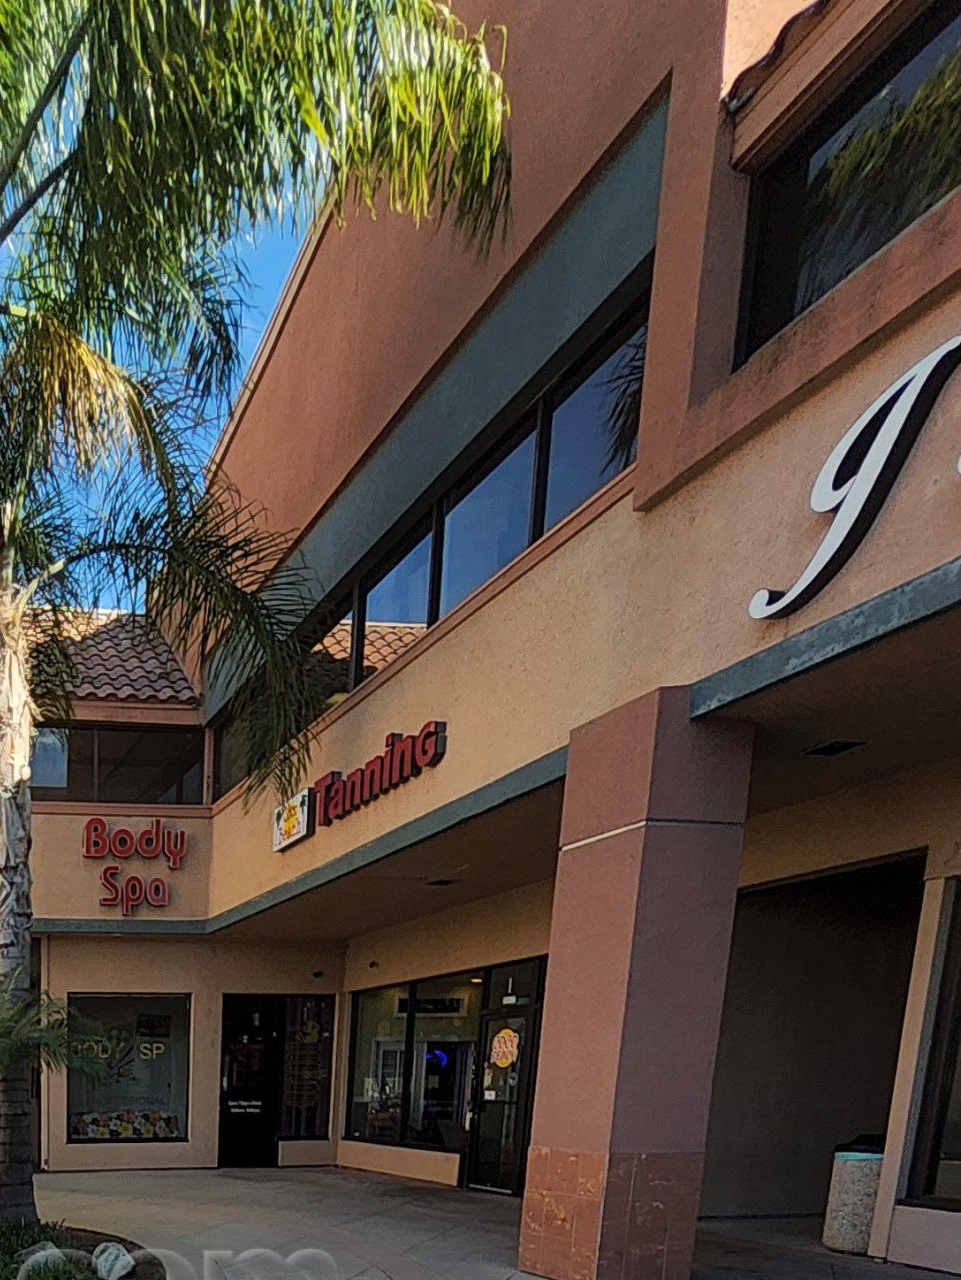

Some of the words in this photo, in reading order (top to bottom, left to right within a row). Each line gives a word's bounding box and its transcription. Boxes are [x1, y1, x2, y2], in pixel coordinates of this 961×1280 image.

[83, 816, 188, 870] Body
[100, 864, 170, 916] Spa
[139, 1042, 165, 1060] SP
